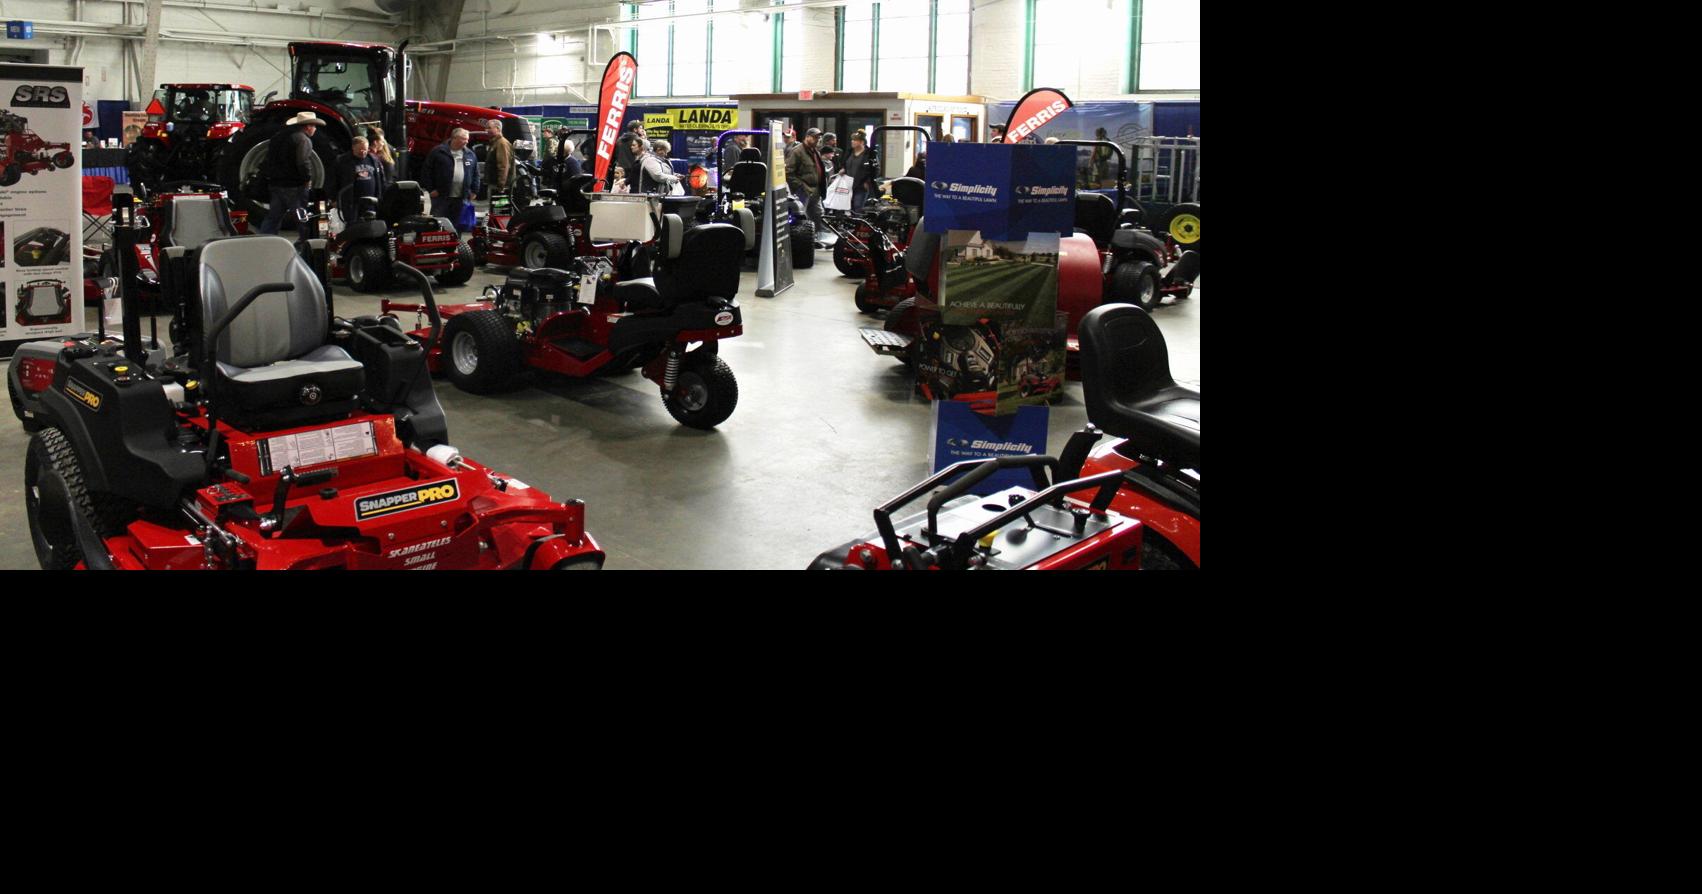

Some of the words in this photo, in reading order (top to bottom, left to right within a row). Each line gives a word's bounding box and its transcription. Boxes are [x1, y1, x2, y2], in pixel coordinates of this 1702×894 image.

[15, 85, 66, 102] SRS
[597, 65, 633, 160] FERRIS
[679, 110, 732, 124] LANDA
[1006, 100, 1066, 143] FERRIS
[949, 182, 998, 196] Simplicity
[1030, 185, 1068, 197] Simplicity
[422, 234, 450, 242] FERRIS
[84, 391, 99, 407] PRO
[971, 440, 1032, 454] Simplicity
[359, 492, 417, 512] SNAPPER
[417, 484, 454, 502] PRO
